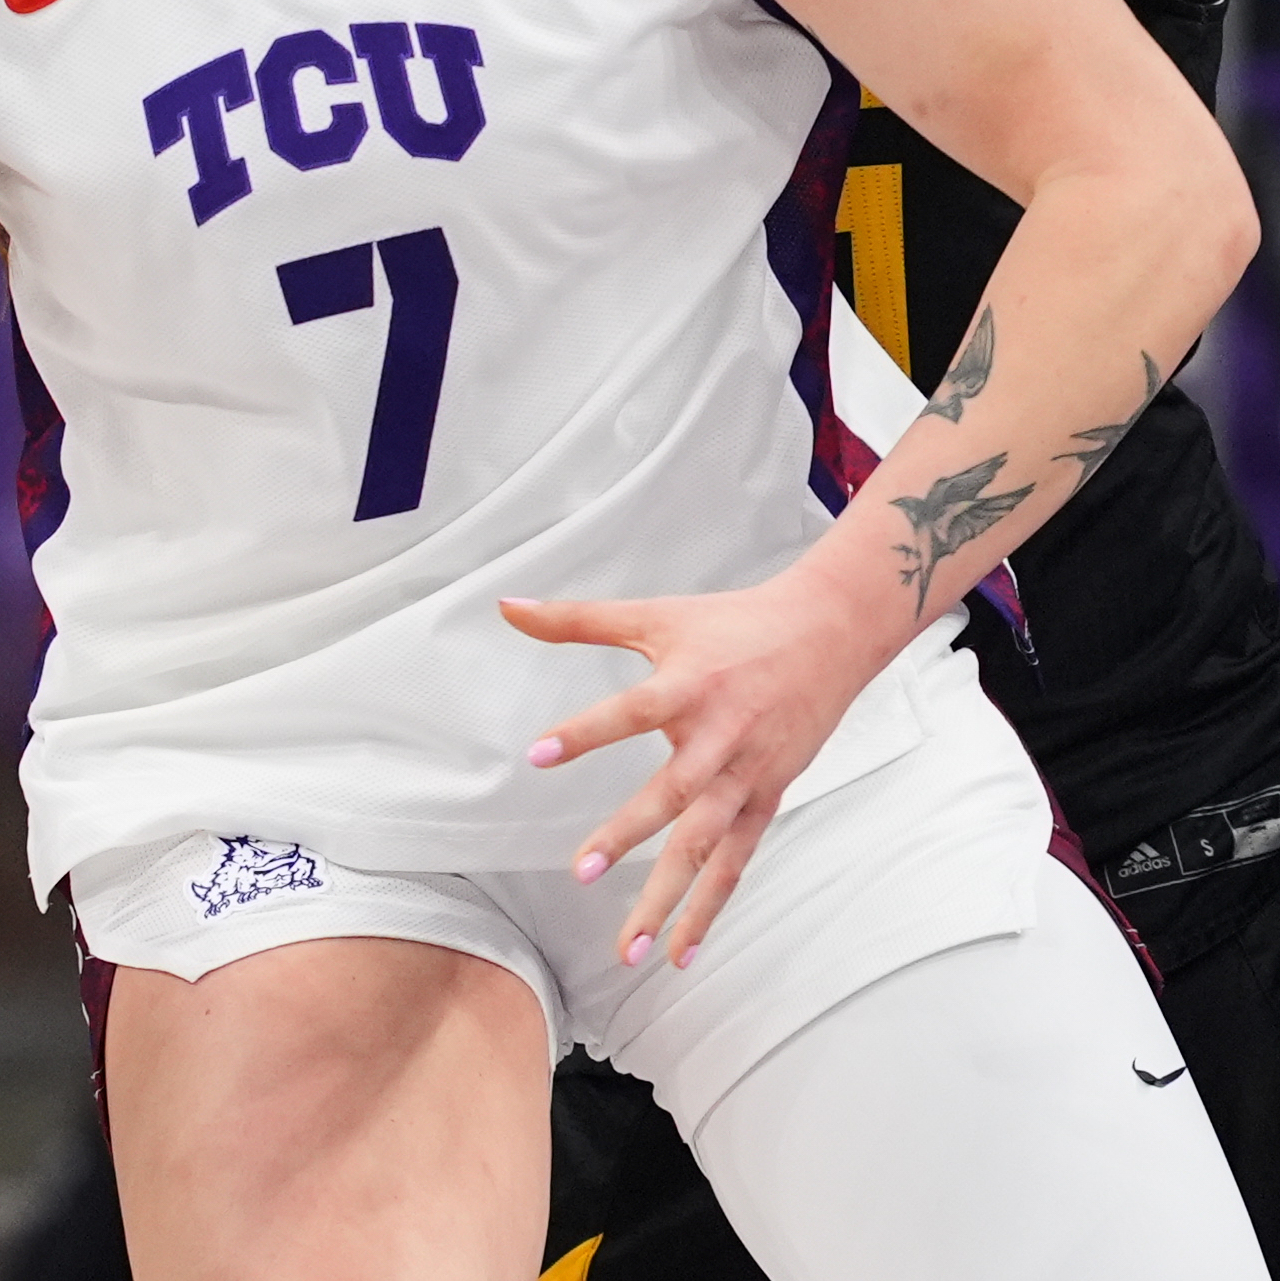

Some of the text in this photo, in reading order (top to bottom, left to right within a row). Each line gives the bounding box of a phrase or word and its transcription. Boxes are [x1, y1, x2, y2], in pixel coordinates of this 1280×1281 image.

[143, 22, 487, 227] TCU
[276, 227, 459, 522] 7
[1119, 855, 1172, 878] adidas
[1200, 838, 1215, 857] S
